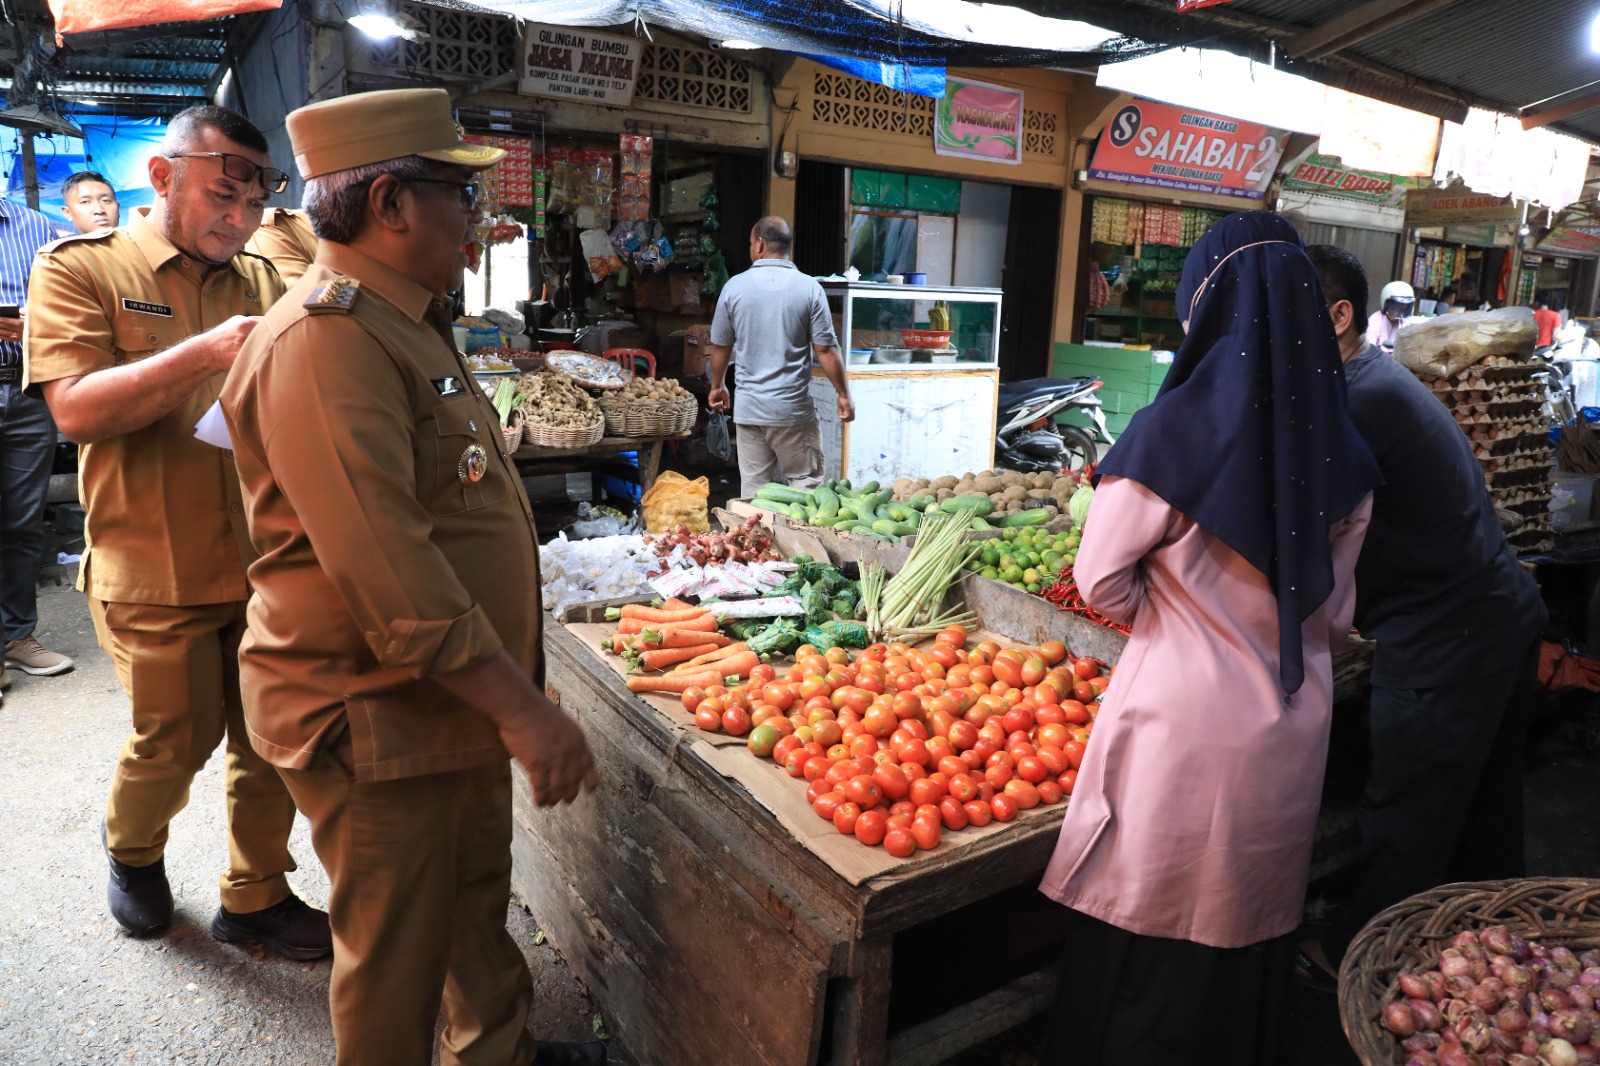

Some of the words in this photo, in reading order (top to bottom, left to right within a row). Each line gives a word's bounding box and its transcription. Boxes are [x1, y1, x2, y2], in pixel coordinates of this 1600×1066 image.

[539, 30, 585, 48] GILINGAN
[591, 39, 629, 55] BUMBU
[528, 43, 572, 71] JASA
[578, 51, 634, 80] MAMA
[529, 69, 559, 80] KOMPLEK
[561, 73, 580, 84] PASAR
[582, 77, 595, 86] IKAN
[548, 83, 572, 94] PANTON
[1113, 111, 1138, 141] S
[1180, 113, 1214, 129] GILINGAN
[1213, 118, 1238, 134] BAKSO
[1134, 126, 1255, 172] SAHABAT
[1244, 135, 1277, 182] 2
[1152, 163, 1179, 177] MENJUAL
[1203, 170, 1225, 183] BAKSO
[1292, 163, 1345, 187] FAIZZ
[1340, 173, 1391, 195] BARU
[1431, 198, 1458, 210] ADEK
[1461, 196, 1498, 209] ABANG
[129, 302, 167, 313] IRWANDI
